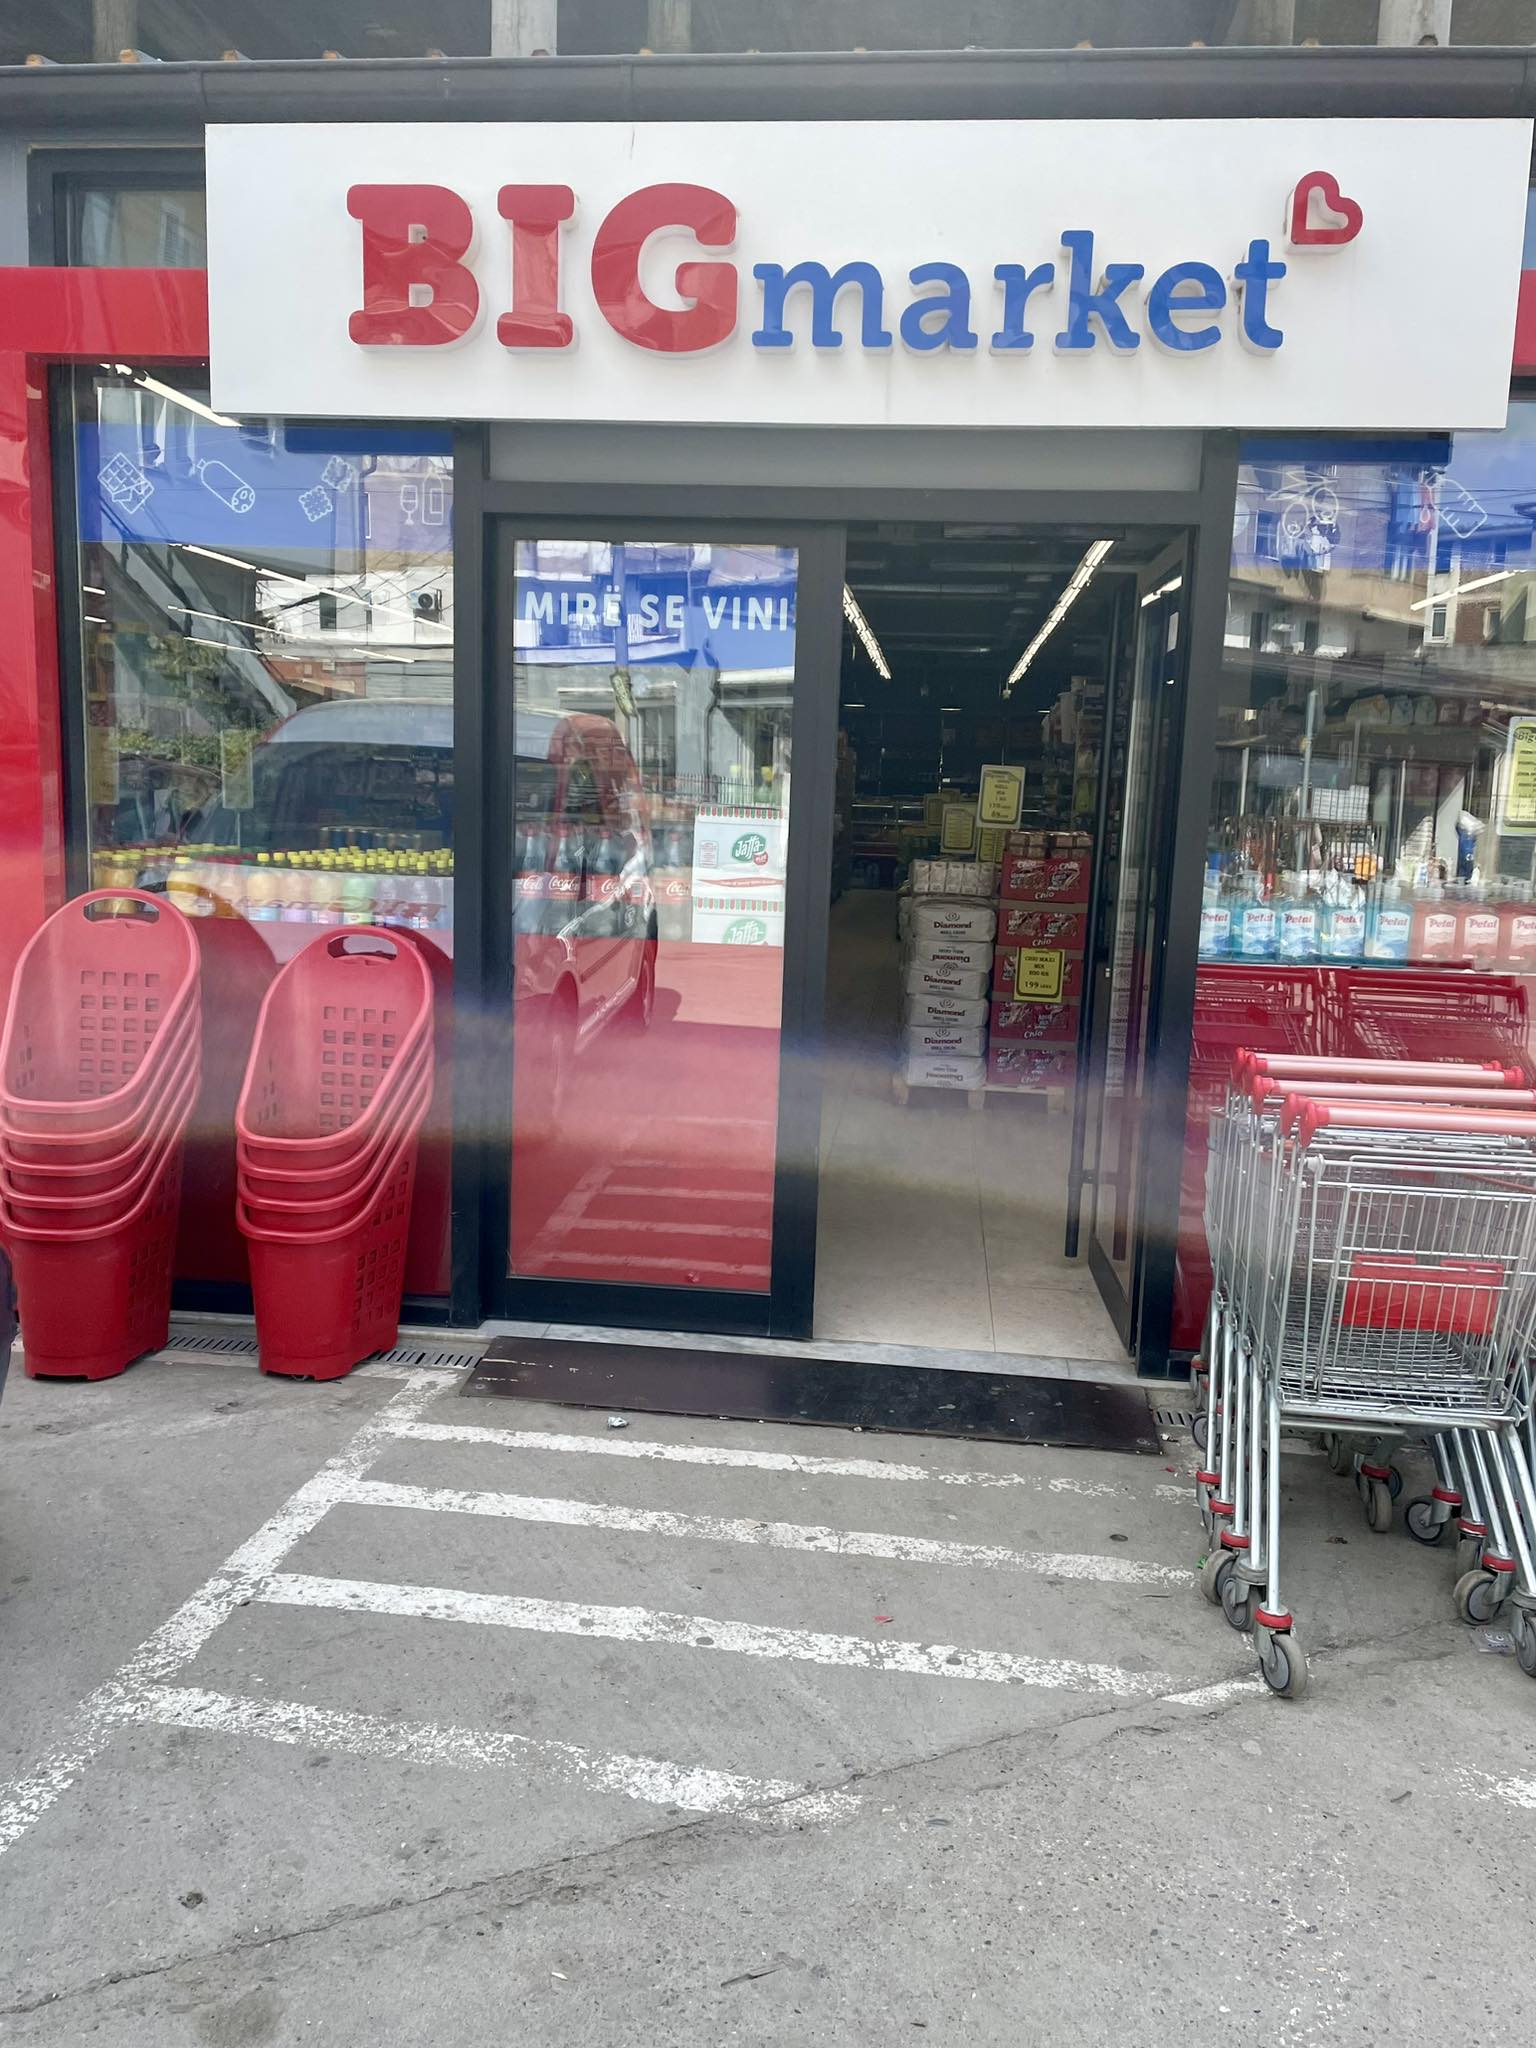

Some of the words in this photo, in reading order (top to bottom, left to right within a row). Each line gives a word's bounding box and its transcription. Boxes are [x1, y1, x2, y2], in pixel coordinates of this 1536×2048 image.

[524, 585, 622, 628] MIRË
[639, 594, 685, 629] SE
[702, 595, 788, 631] VINI
[735, 835, 764, 859] Jaffa
[1034, 891, 1055, 900] Chio
[1202, 913, 1229, 923] Petal
[1247, 912, 1274, 922] Petal
[1285, 913, 1313, 924] Petal
[1379, 914, 1409, 926] Petal
[933, 920, 972, 929] Diamond
[1428, 918, 1455, 929] Petal
[1469, 918, 1498, 929] Petal
[1032, 938, 1052, 947] Chio
[932, 954, 970, 963] Diamond
[923, 975, 962, 986] Diamond
[1025, 981, 1039, 989] 199
[927, 1006, 966, 1017] Diamond
[924, 1036, 962, 1045] Diamond
